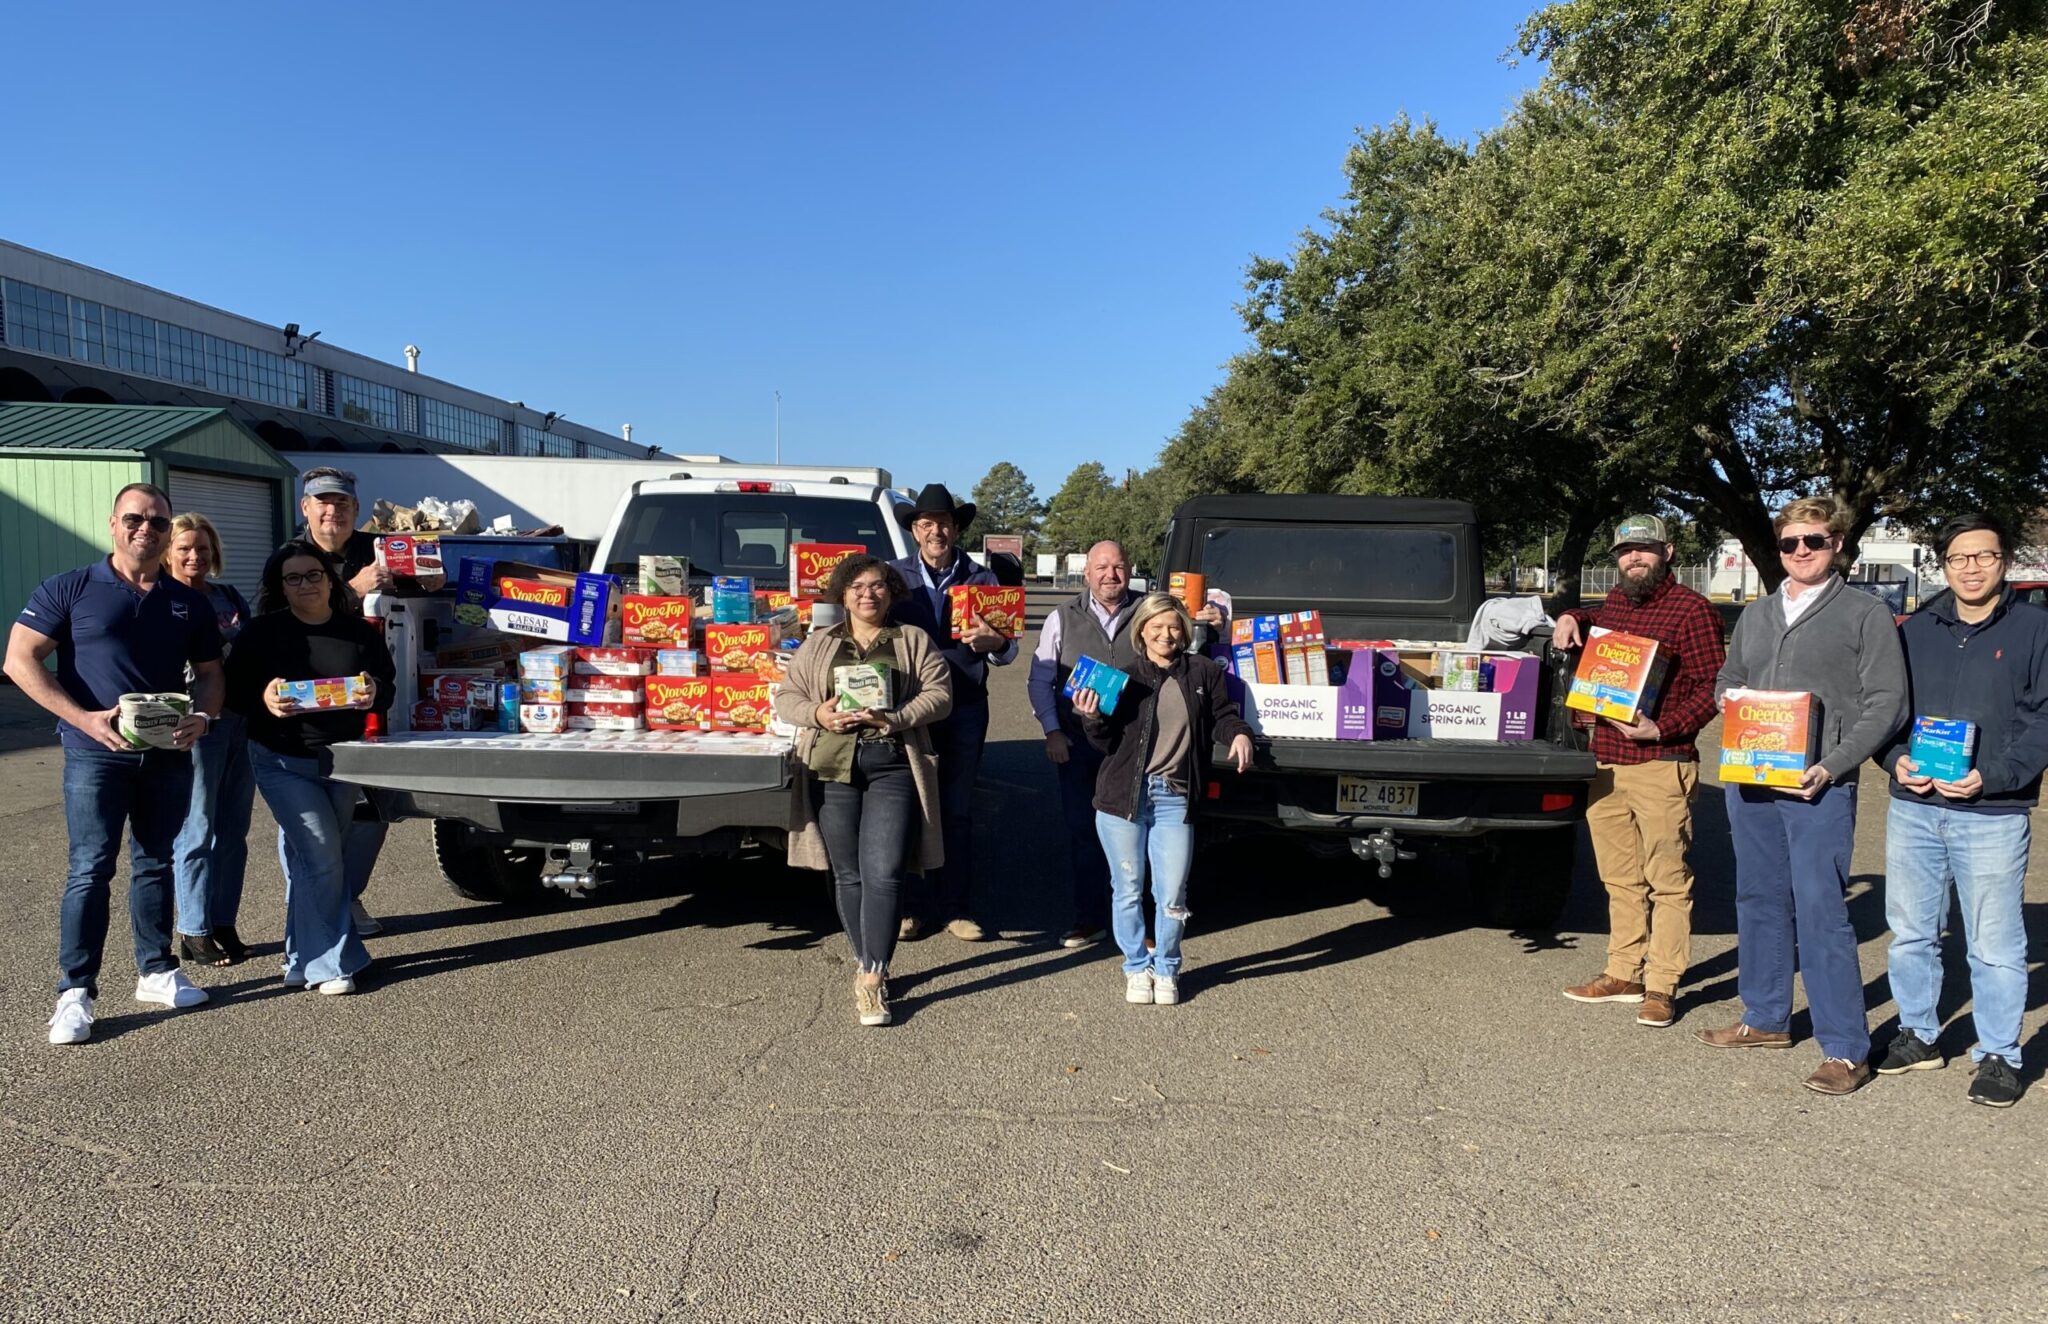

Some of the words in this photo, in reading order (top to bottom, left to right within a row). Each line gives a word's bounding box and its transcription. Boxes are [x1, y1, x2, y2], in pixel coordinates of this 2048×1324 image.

[507, 613, 549, 628] CAESAR
[1596, 642, 1641, 665] Cheerios
[1263, 698, 1318, 709] ORGANIC
[1343, 705, 1349, 714] 1
[1352, 705, 1366, 714] LB
[1428, 703, 1482, 715] ORGANIC
[1256, 709, 1300, 720] SPRING
[1301, 711, 1324, 721] MIX
[1420, 714, 1463, 725] SPRING
[1466, 715, 1488, 726] MIX
[1506, 711, 1511, 720] 1
[1513, 711, 1527, 720] LB
[1739, 705, 1795, 723] Cheerios
[1340, 784, 1368, 803] MI2
[1377, 785, 1416, 805] 4837
